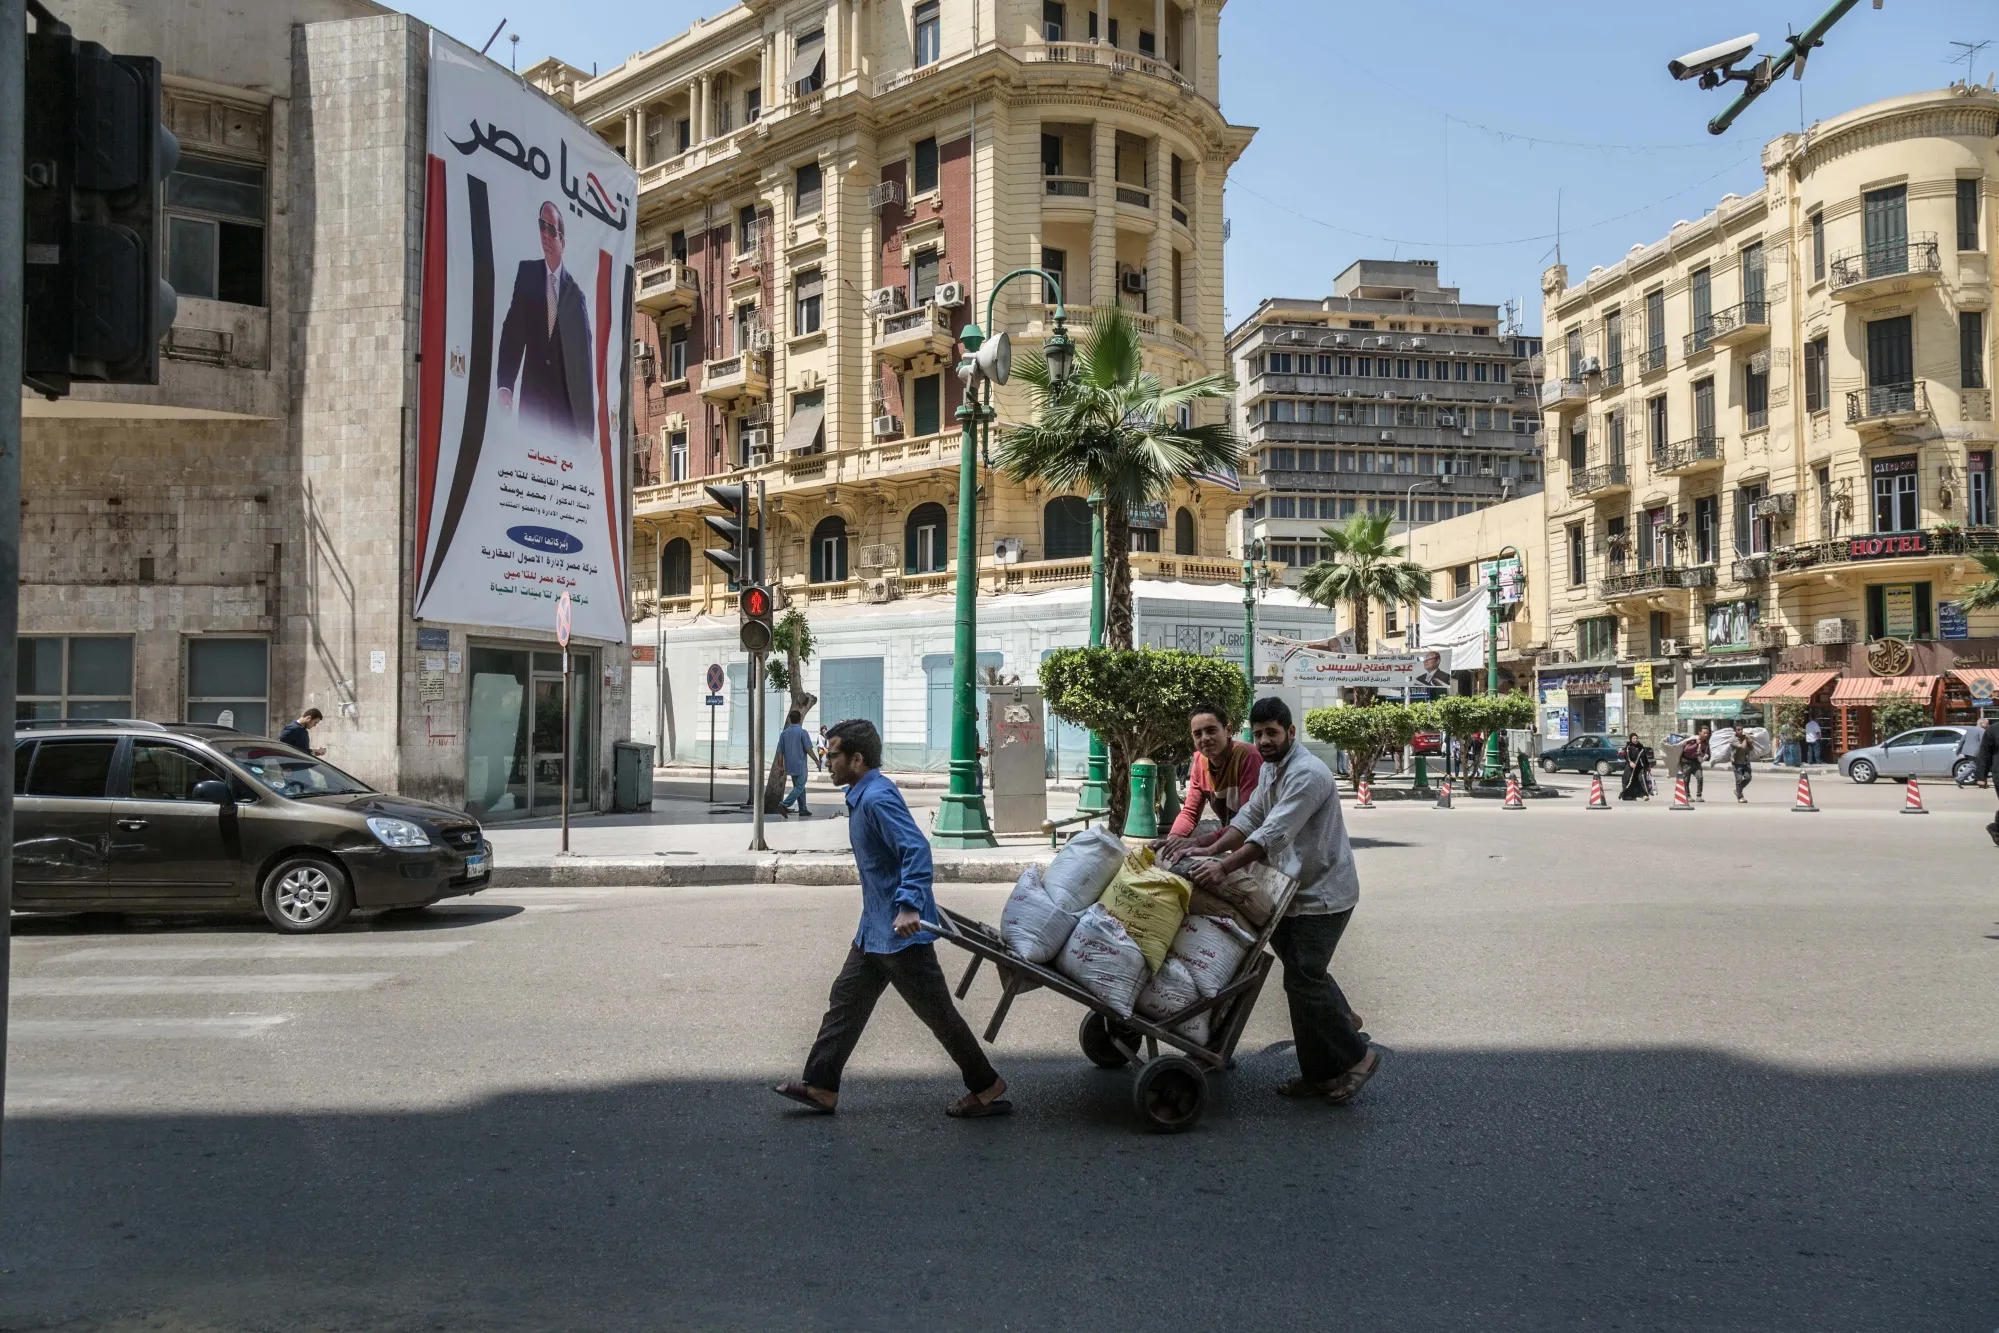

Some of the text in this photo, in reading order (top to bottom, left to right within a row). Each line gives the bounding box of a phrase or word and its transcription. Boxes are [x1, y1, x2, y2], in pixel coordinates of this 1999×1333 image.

[444, 119, 630, 231] تحيا مصر
[528, 449, 573, 472] مع تحيات
[531, 473, 559, 487] القابضة
[500, 483, 523, 499] يوسف
[561, 483, 577, 491] مصر
[580, 484, 595, 497] شركة
[526, 490, 546, 500] محمد
[555, 497, 574, 505] الدكتور
[499, 500, 520, 509] المنتدب
[521, 504, 541, 515] والعضو
[523, 533, 569, 550] وشركاتها التابعة
[1850, 536, 1927, 556] HOTEL
[481, 545, 514, 559] العقارية
[566, 562, 580, 571] مصر
[582, 562, 598, 575] شركة
[539, 575, 553, 583] مصر
[556, 574, 576, 587] شركة
[490, 582, 517, 596] الحياة
[1362, 663, 1392, 673] الفتاح
[1394, 664, 1413, 673] عبد
